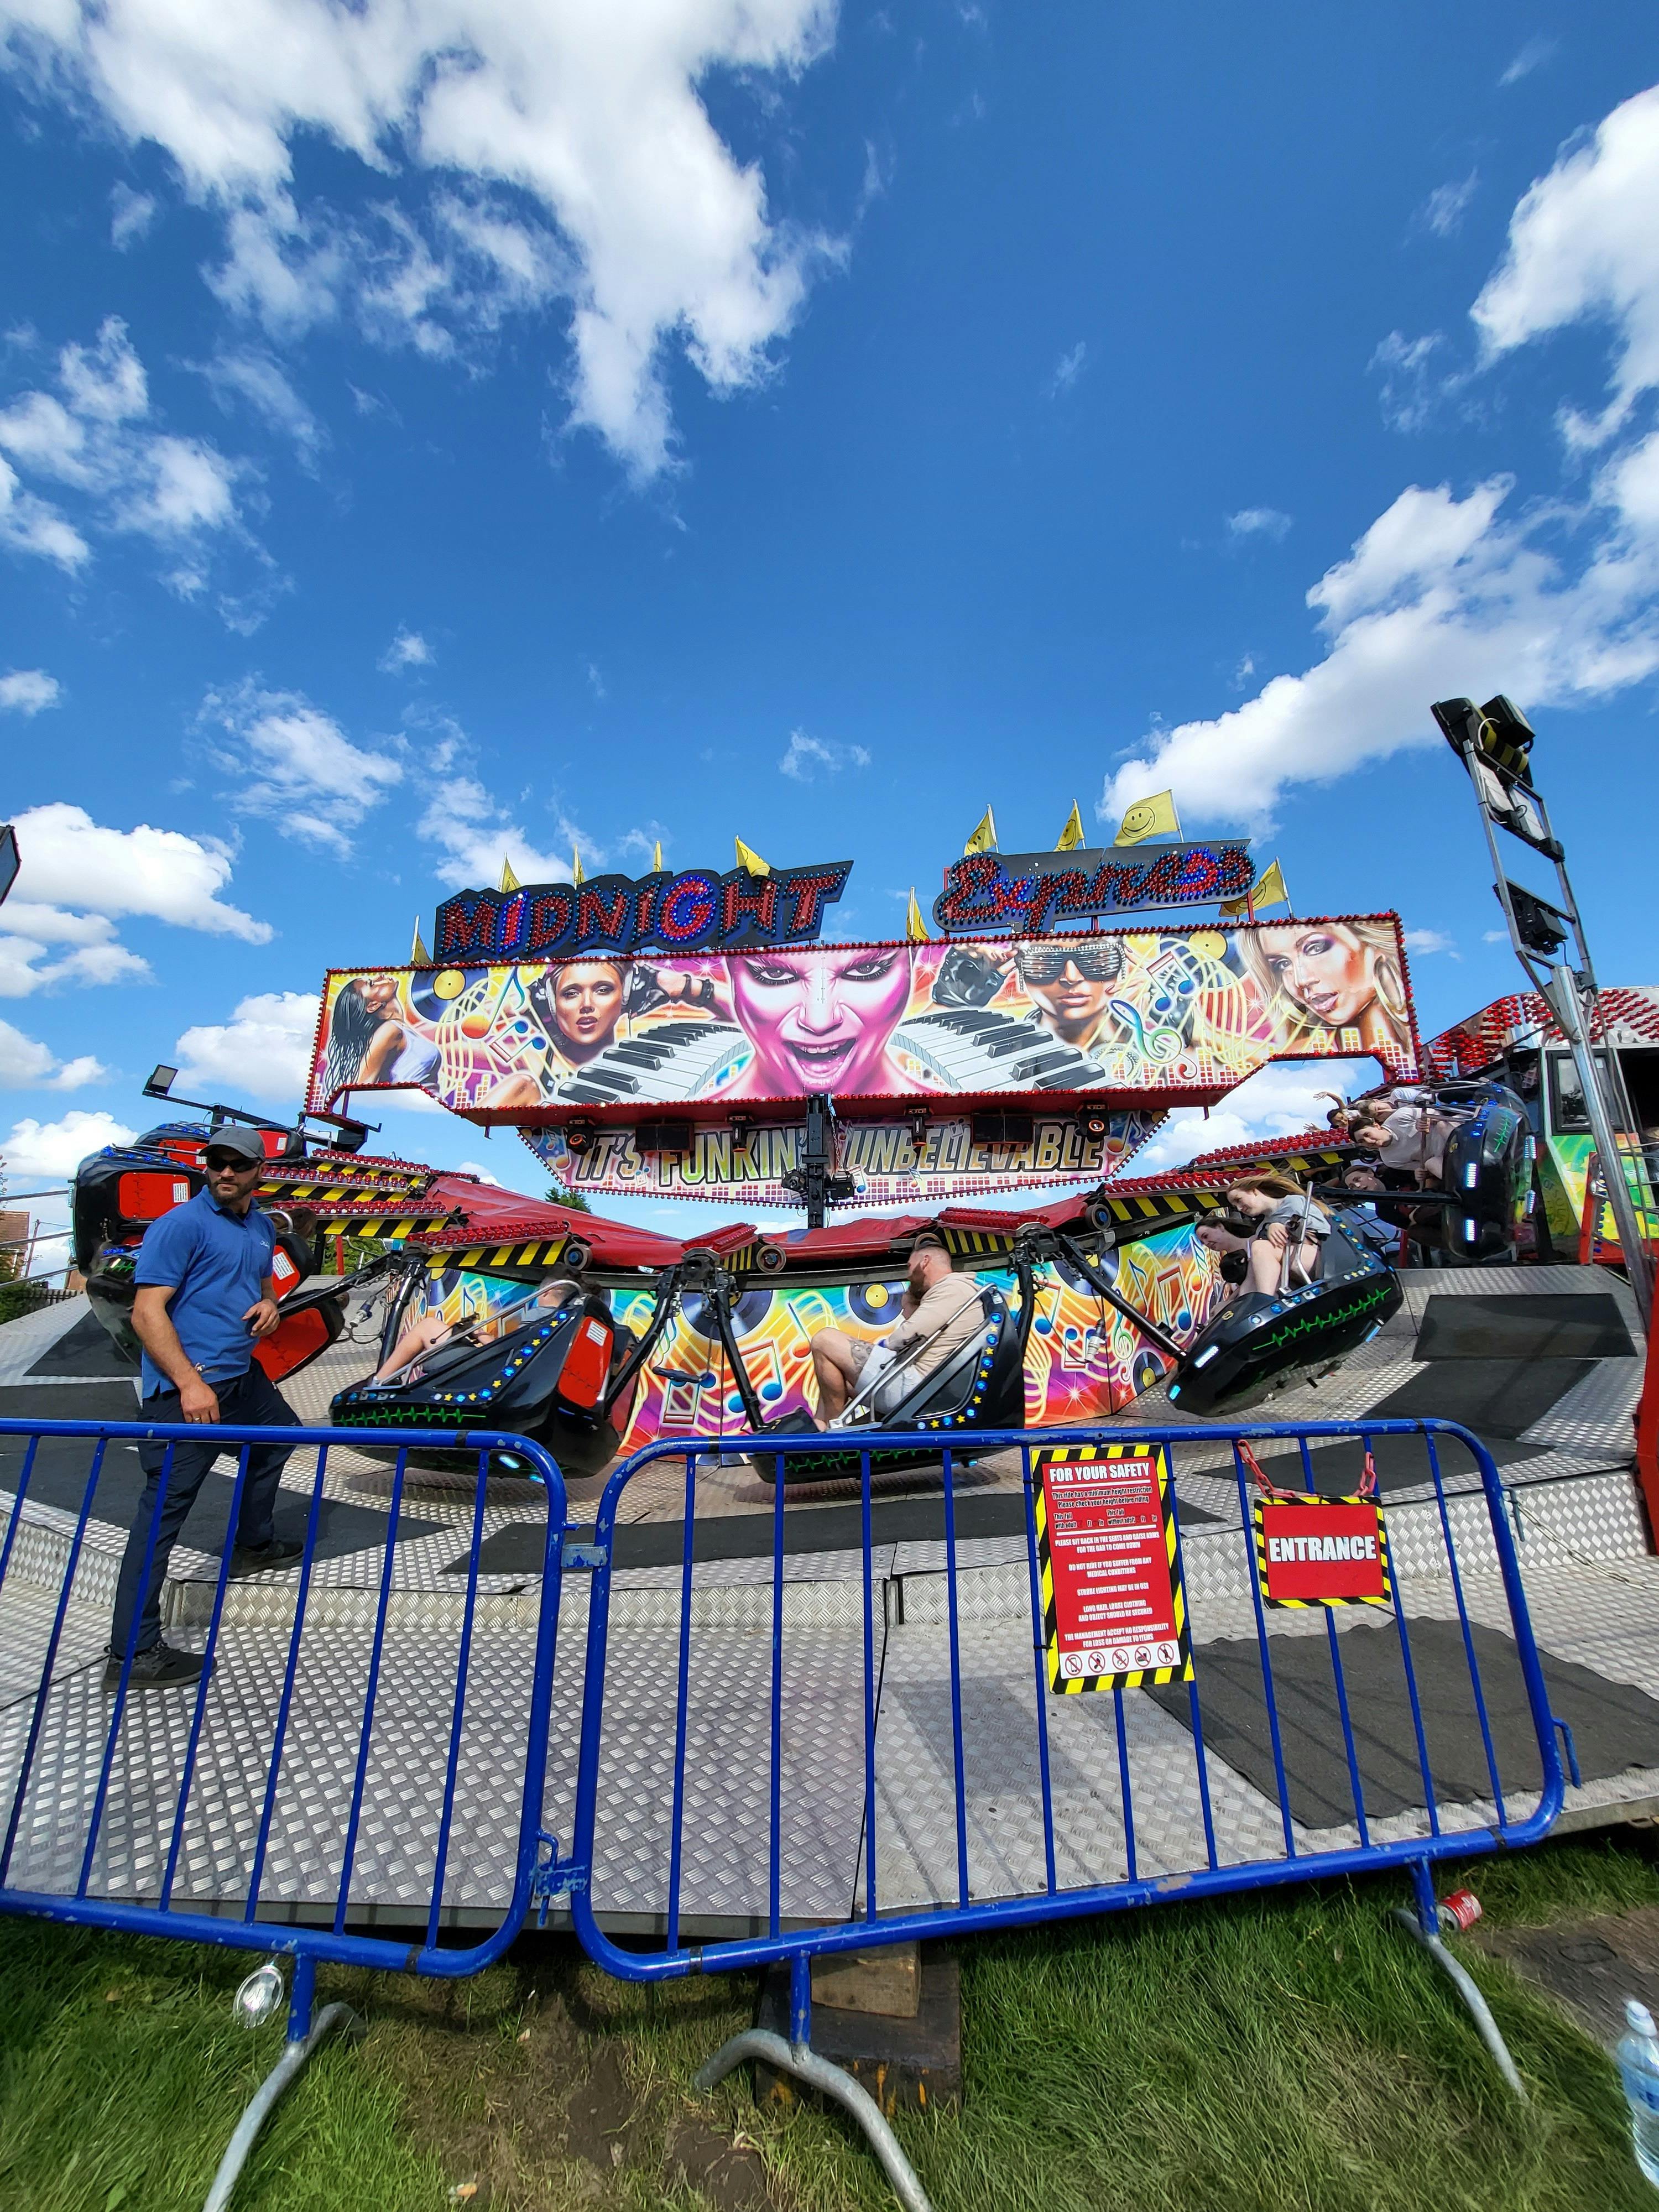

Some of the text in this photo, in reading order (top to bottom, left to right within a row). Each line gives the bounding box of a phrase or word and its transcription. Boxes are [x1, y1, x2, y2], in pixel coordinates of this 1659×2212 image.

[440, 844, 1256, 955] MIDNIGHT Express
[575, 1133, 645, 1181] IT'S
[844, 1122, 1105, 1175] UNBELIEVABLE
[1050, 1463, 1150, 1482] FOR YOUR SAFETY
[1268, 1536, 1377, 1562] ENTRANCE
[1087, 1567, 1136, 1578] MEDICAL CONDITIONS
[1096, 1586, 1117, 1594] LIGHTING
[1109, 1602, 1124, 1610] LOOSE
[1124, 1599, 1146, 1608] CLOTHING
[1074, 1630, 1107, 1640] MANAGEMENT
[1133, 1623, 1169, 1633] RESPONSIBILITY
[1113, 1636, 1132, 1644] DAMAGE
